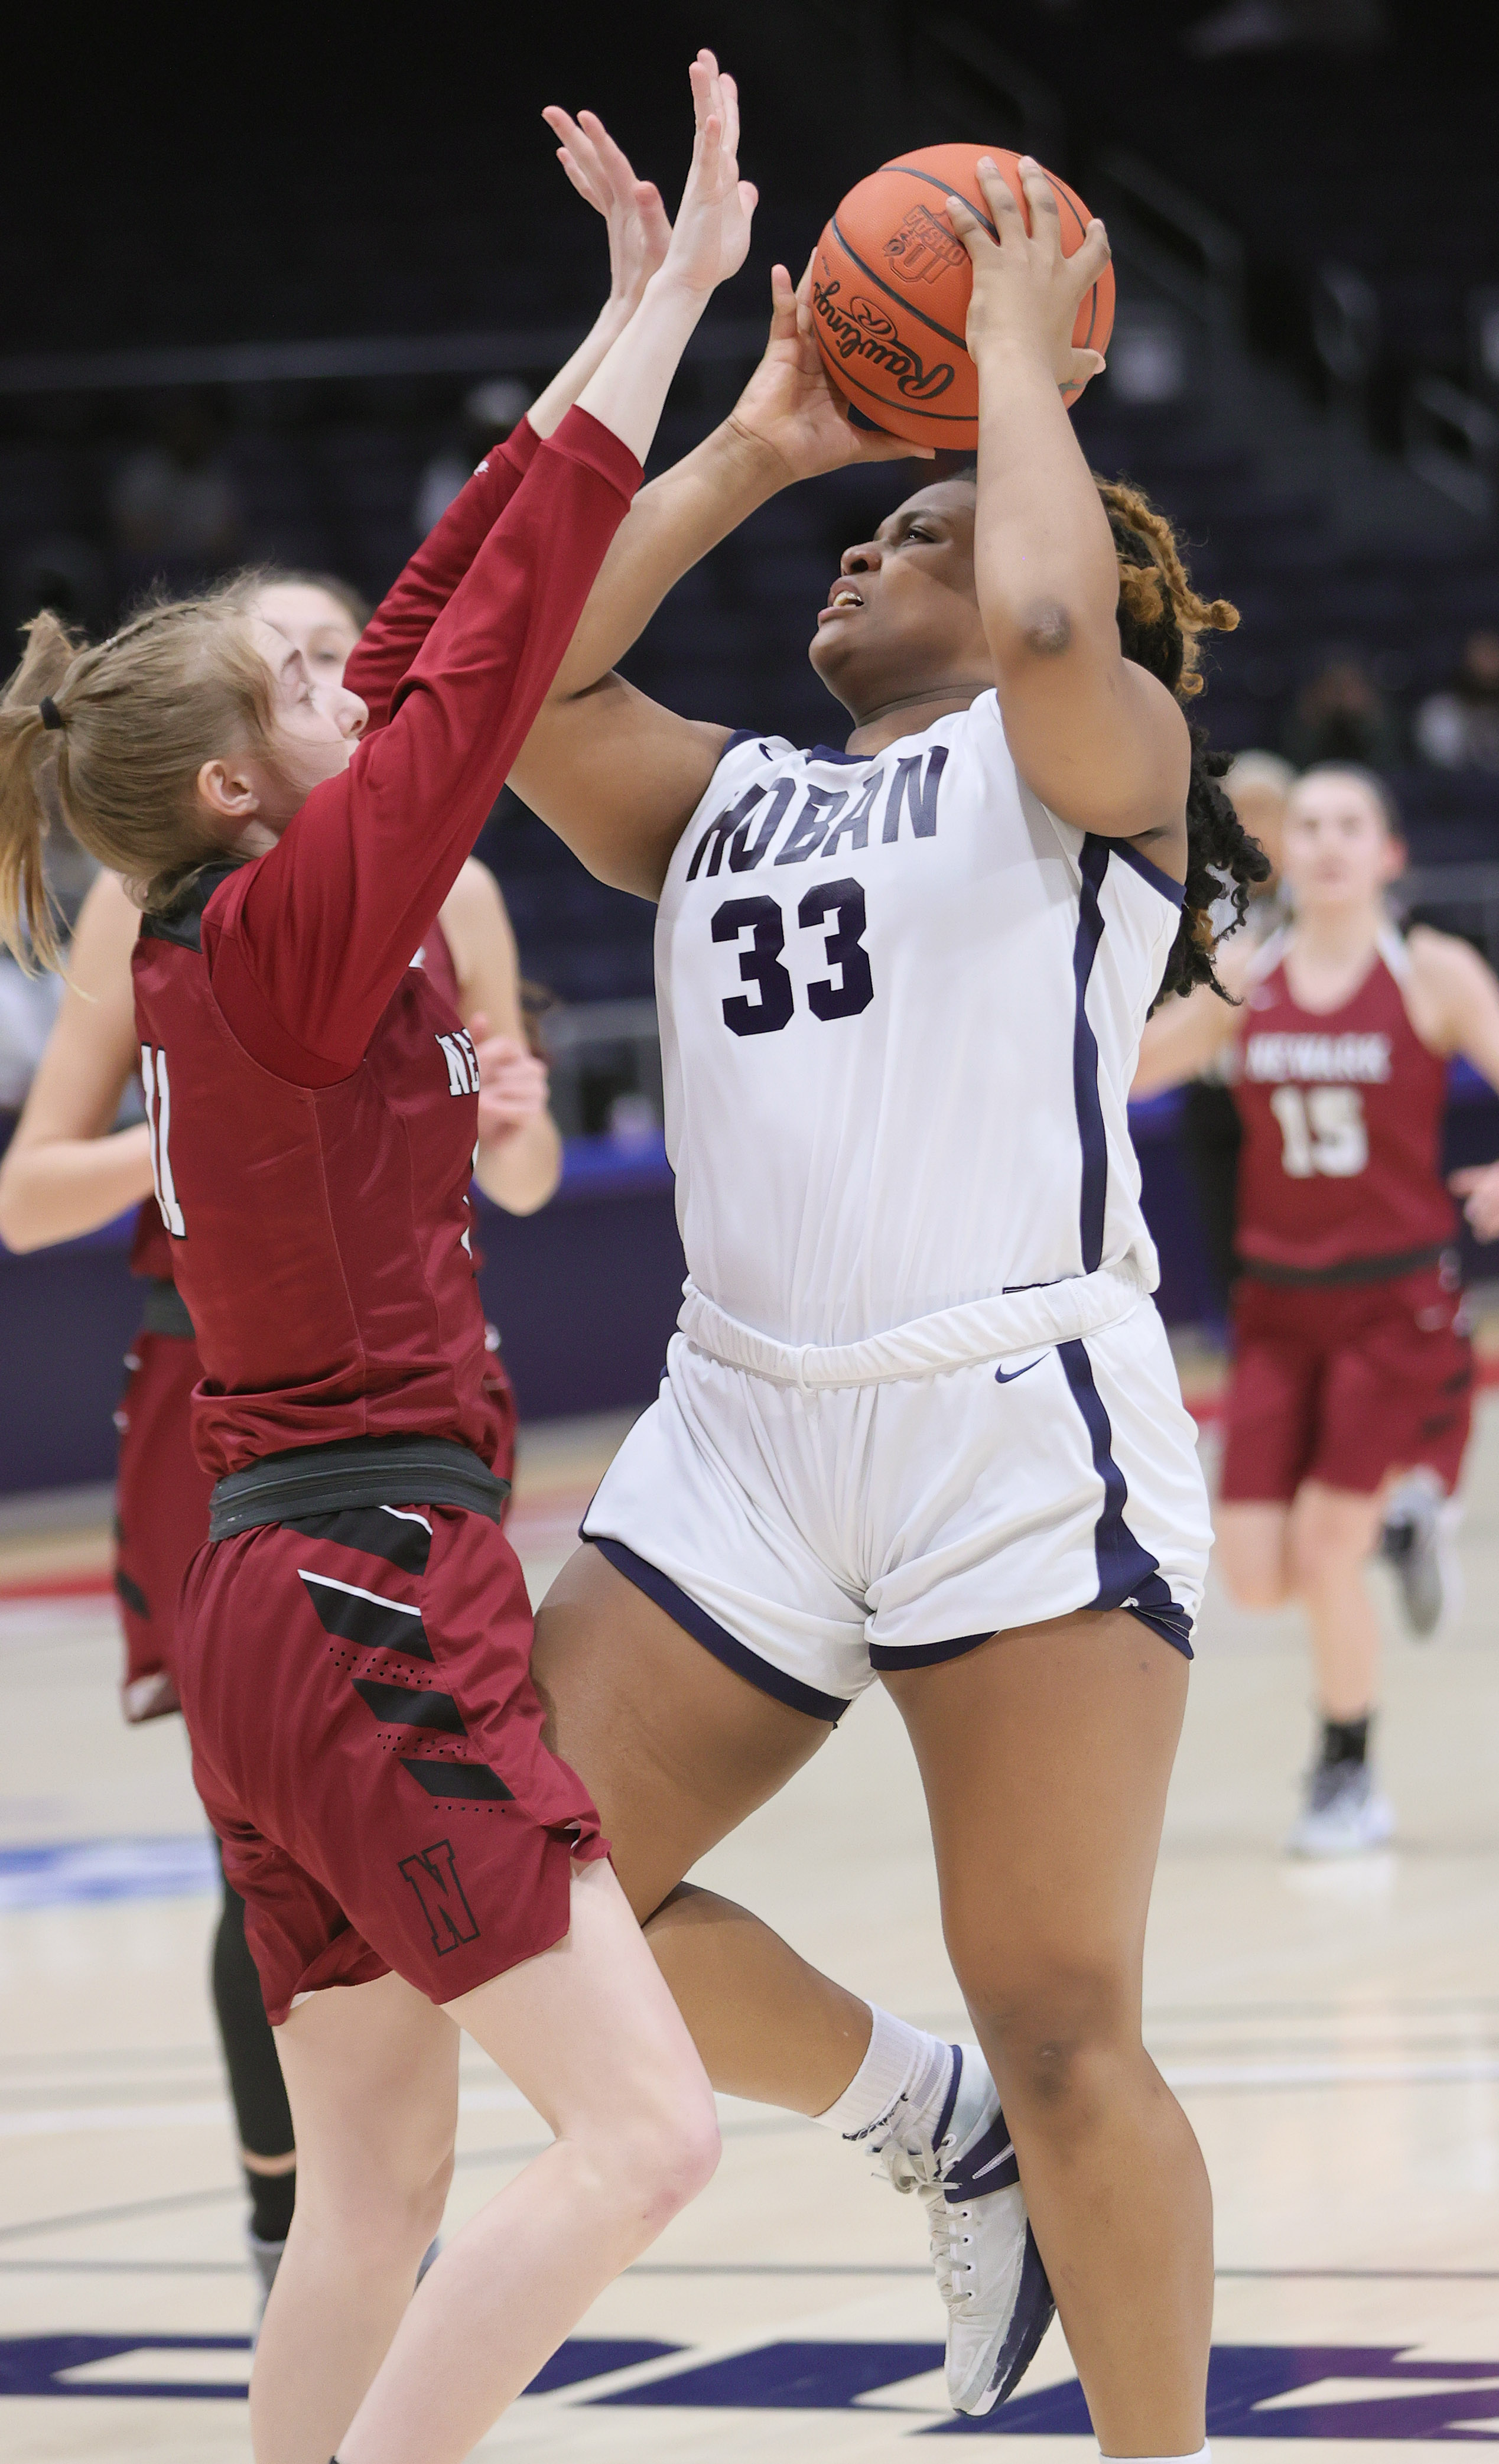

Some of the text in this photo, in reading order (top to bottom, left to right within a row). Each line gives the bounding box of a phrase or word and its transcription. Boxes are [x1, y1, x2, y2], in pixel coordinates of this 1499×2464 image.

[814, 279, 955, 400] Rawlings
[686, 746, 949, 882] HOBAN
[711, 877, 874, 1036] 33
[1270, 1085, 1369, 1178] 15
[398, 1839, 480, 1956] N
